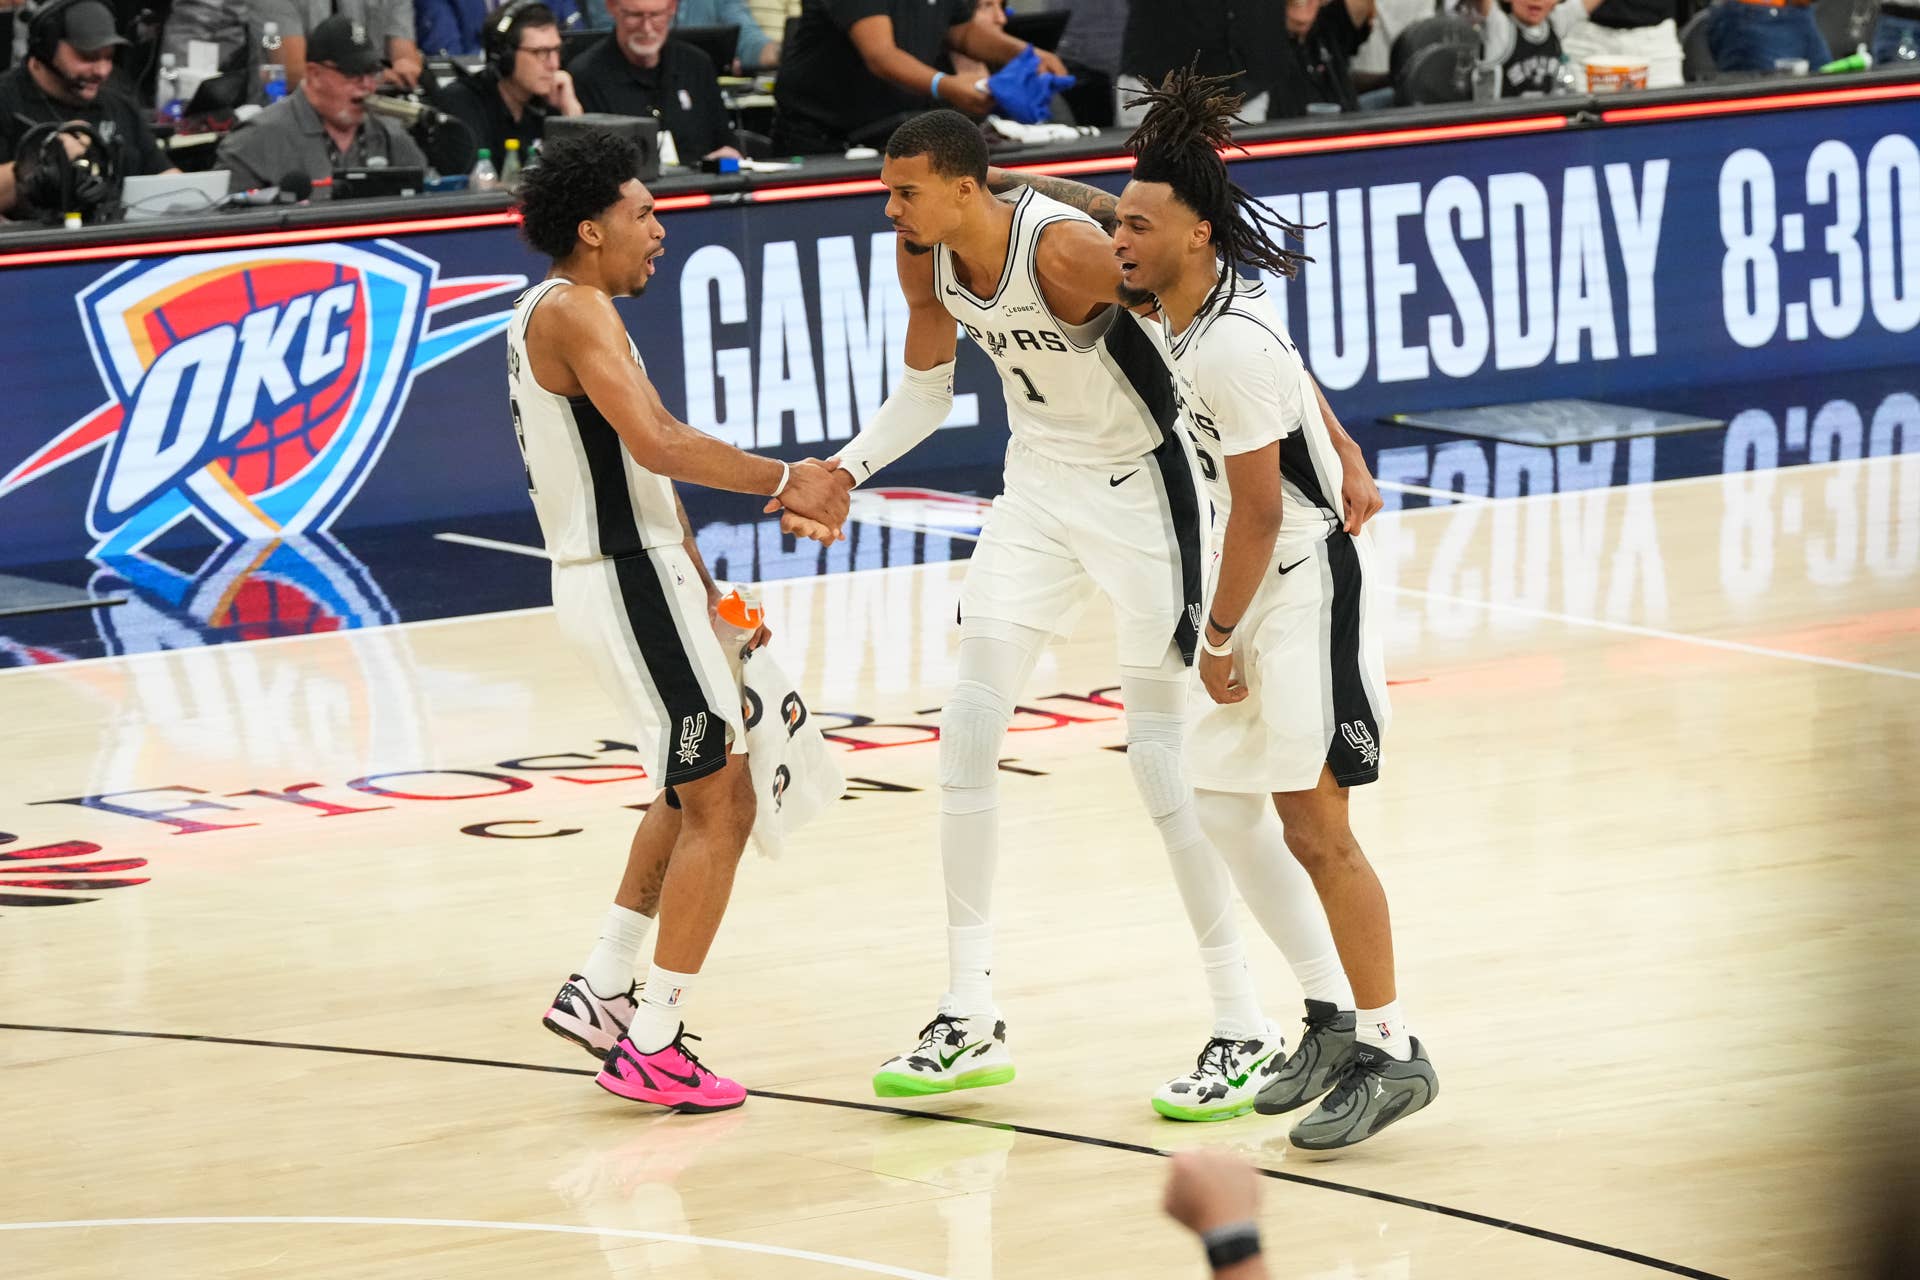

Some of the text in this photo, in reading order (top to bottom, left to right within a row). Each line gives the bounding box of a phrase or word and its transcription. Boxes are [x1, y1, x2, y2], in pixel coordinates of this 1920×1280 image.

[680, 231, 979, 449] GAM
[1239, 158, 1670, 391] TUESDAY
[1718, 133, 1920, 348] 8:30
[1007, 304, 1035, 314] LEDGER
[106, 283, 356, 514] OKC
[1010, 366, 1048, 406] 1
